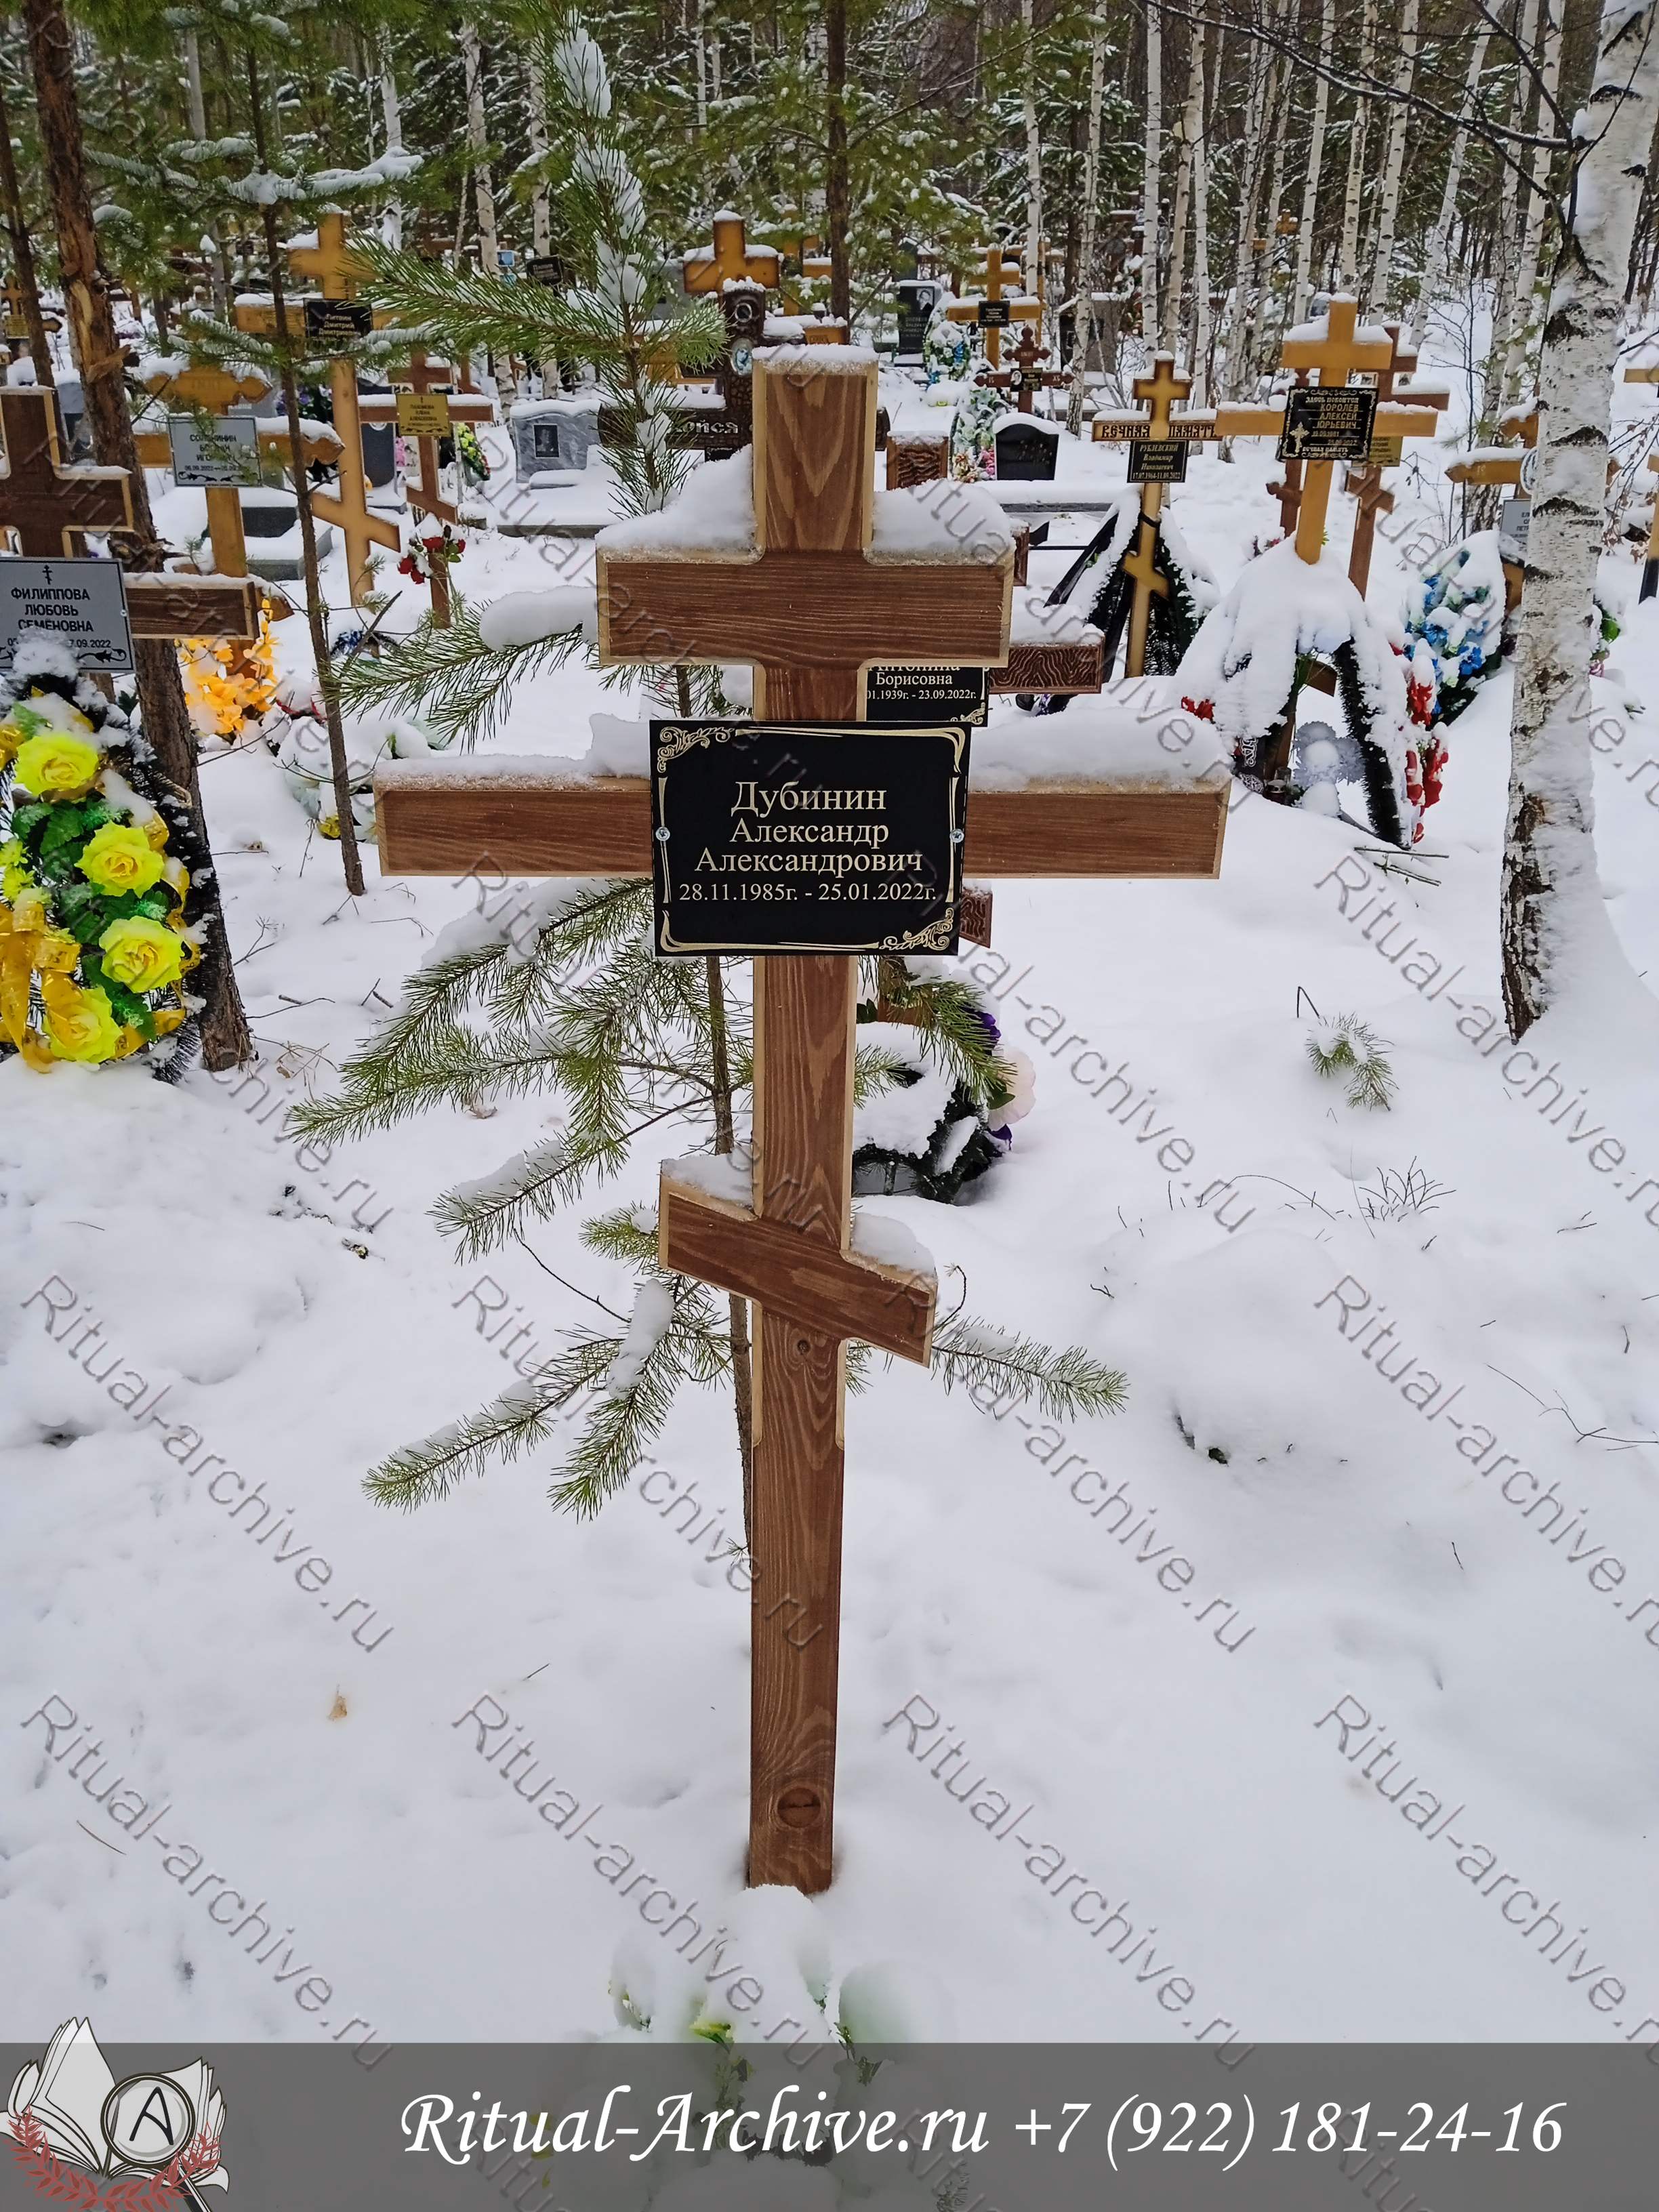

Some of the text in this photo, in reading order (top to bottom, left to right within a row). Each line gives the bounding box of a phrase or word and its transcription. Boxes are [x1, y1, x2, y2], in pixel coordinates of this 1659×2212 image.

[1320, 403, 1359, 412] КОРОЛЕВ
[1319, 412, 1357, 420] АЛЕКСЕЙ
[11, 588, 91, 600] ФИЛИППОВА
[24, 605, 79, 616] ЛЮБОВЬ
[68, 639, 112, 649] 7.09.2022
[875, 672, 954, 689] Борисовна
[918, 689, 977, 700] 23.09.2022г.
[731, 781, 887, 818] Дубинин
[729, 817, 889, 850] Александр
[694, 847, 923, 878] Александрович
[679, 884, 798, 901] 28.11.1985г.
[819, 883, 936, 901] 25.01.2022г.
